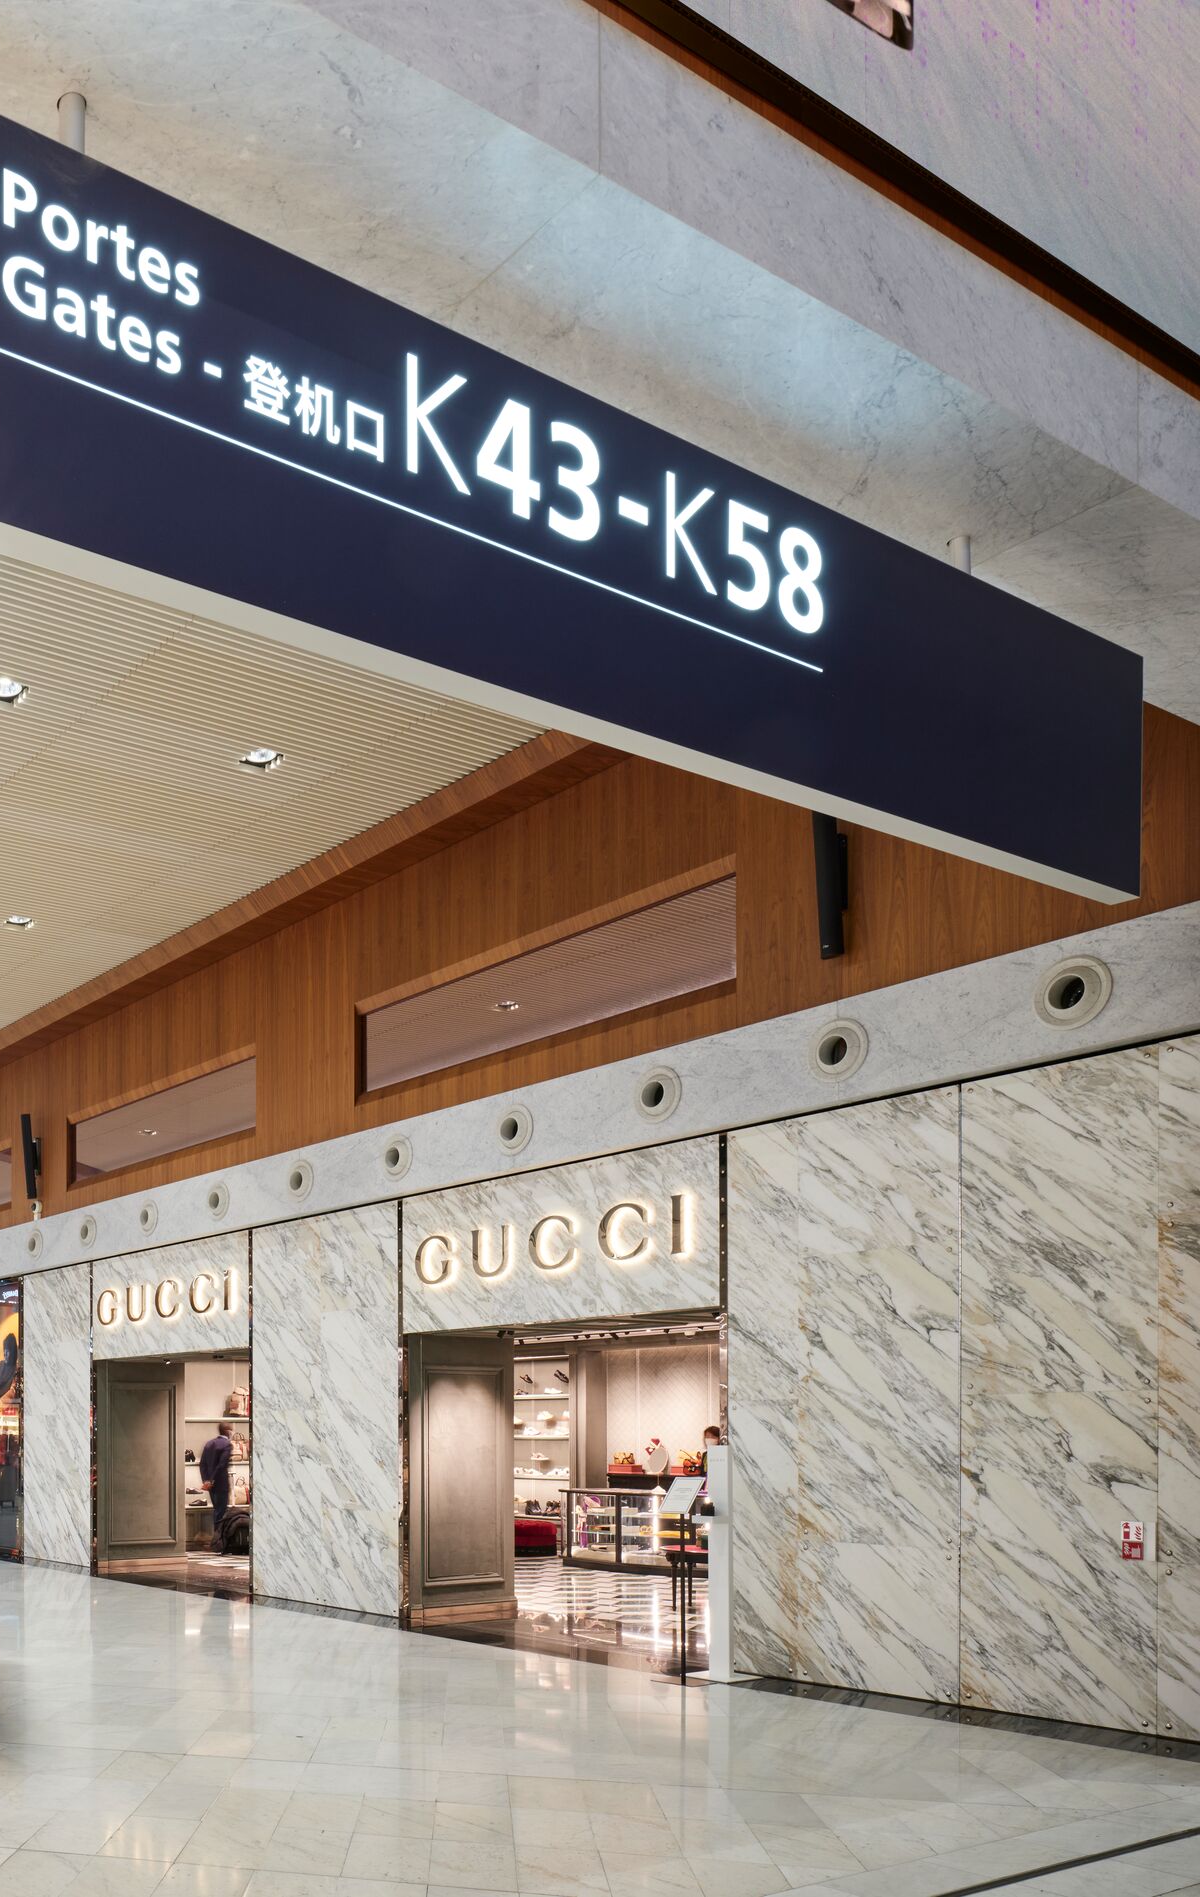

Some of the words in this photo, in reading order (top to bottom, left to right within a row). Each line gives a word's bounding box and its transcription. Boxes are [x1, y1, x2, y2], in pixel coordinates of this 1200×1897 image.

[2, 166, 202, 307] Portes
[1, 255, 183, 376] Gates
[242, 353, 386, 463] 登机口
[96, 1269, 233, 1326] GUCCI
[413, 1193, 688, 1286] GUCCI
